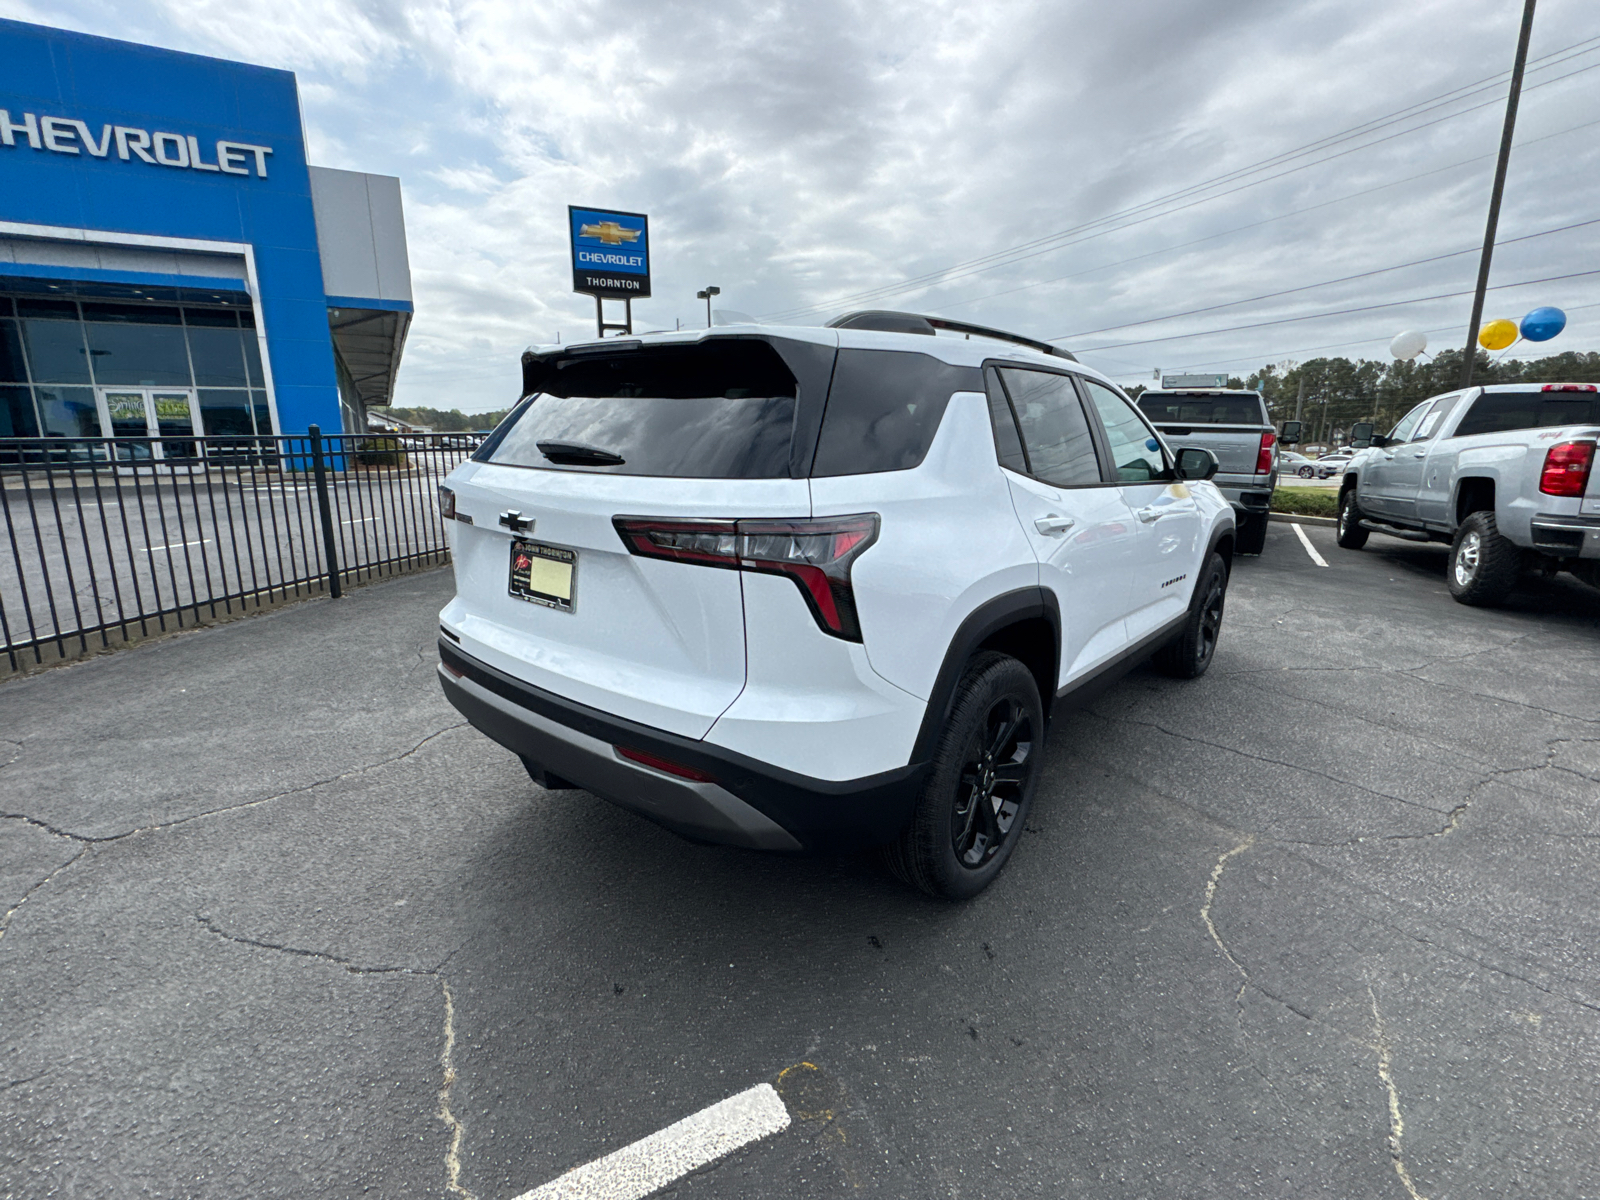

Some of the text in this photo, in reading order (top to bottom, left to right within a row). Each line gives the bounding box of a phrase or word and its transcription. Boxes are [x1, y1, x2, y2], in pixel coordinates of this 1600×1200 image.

[0, 109, 273, 178] HEVROLET
[579, 252, 642, 266] CHEVROLET
[586, 277, 639, 289] THORNTON
[525, 544, 572, 559] JOHN THORNTON
